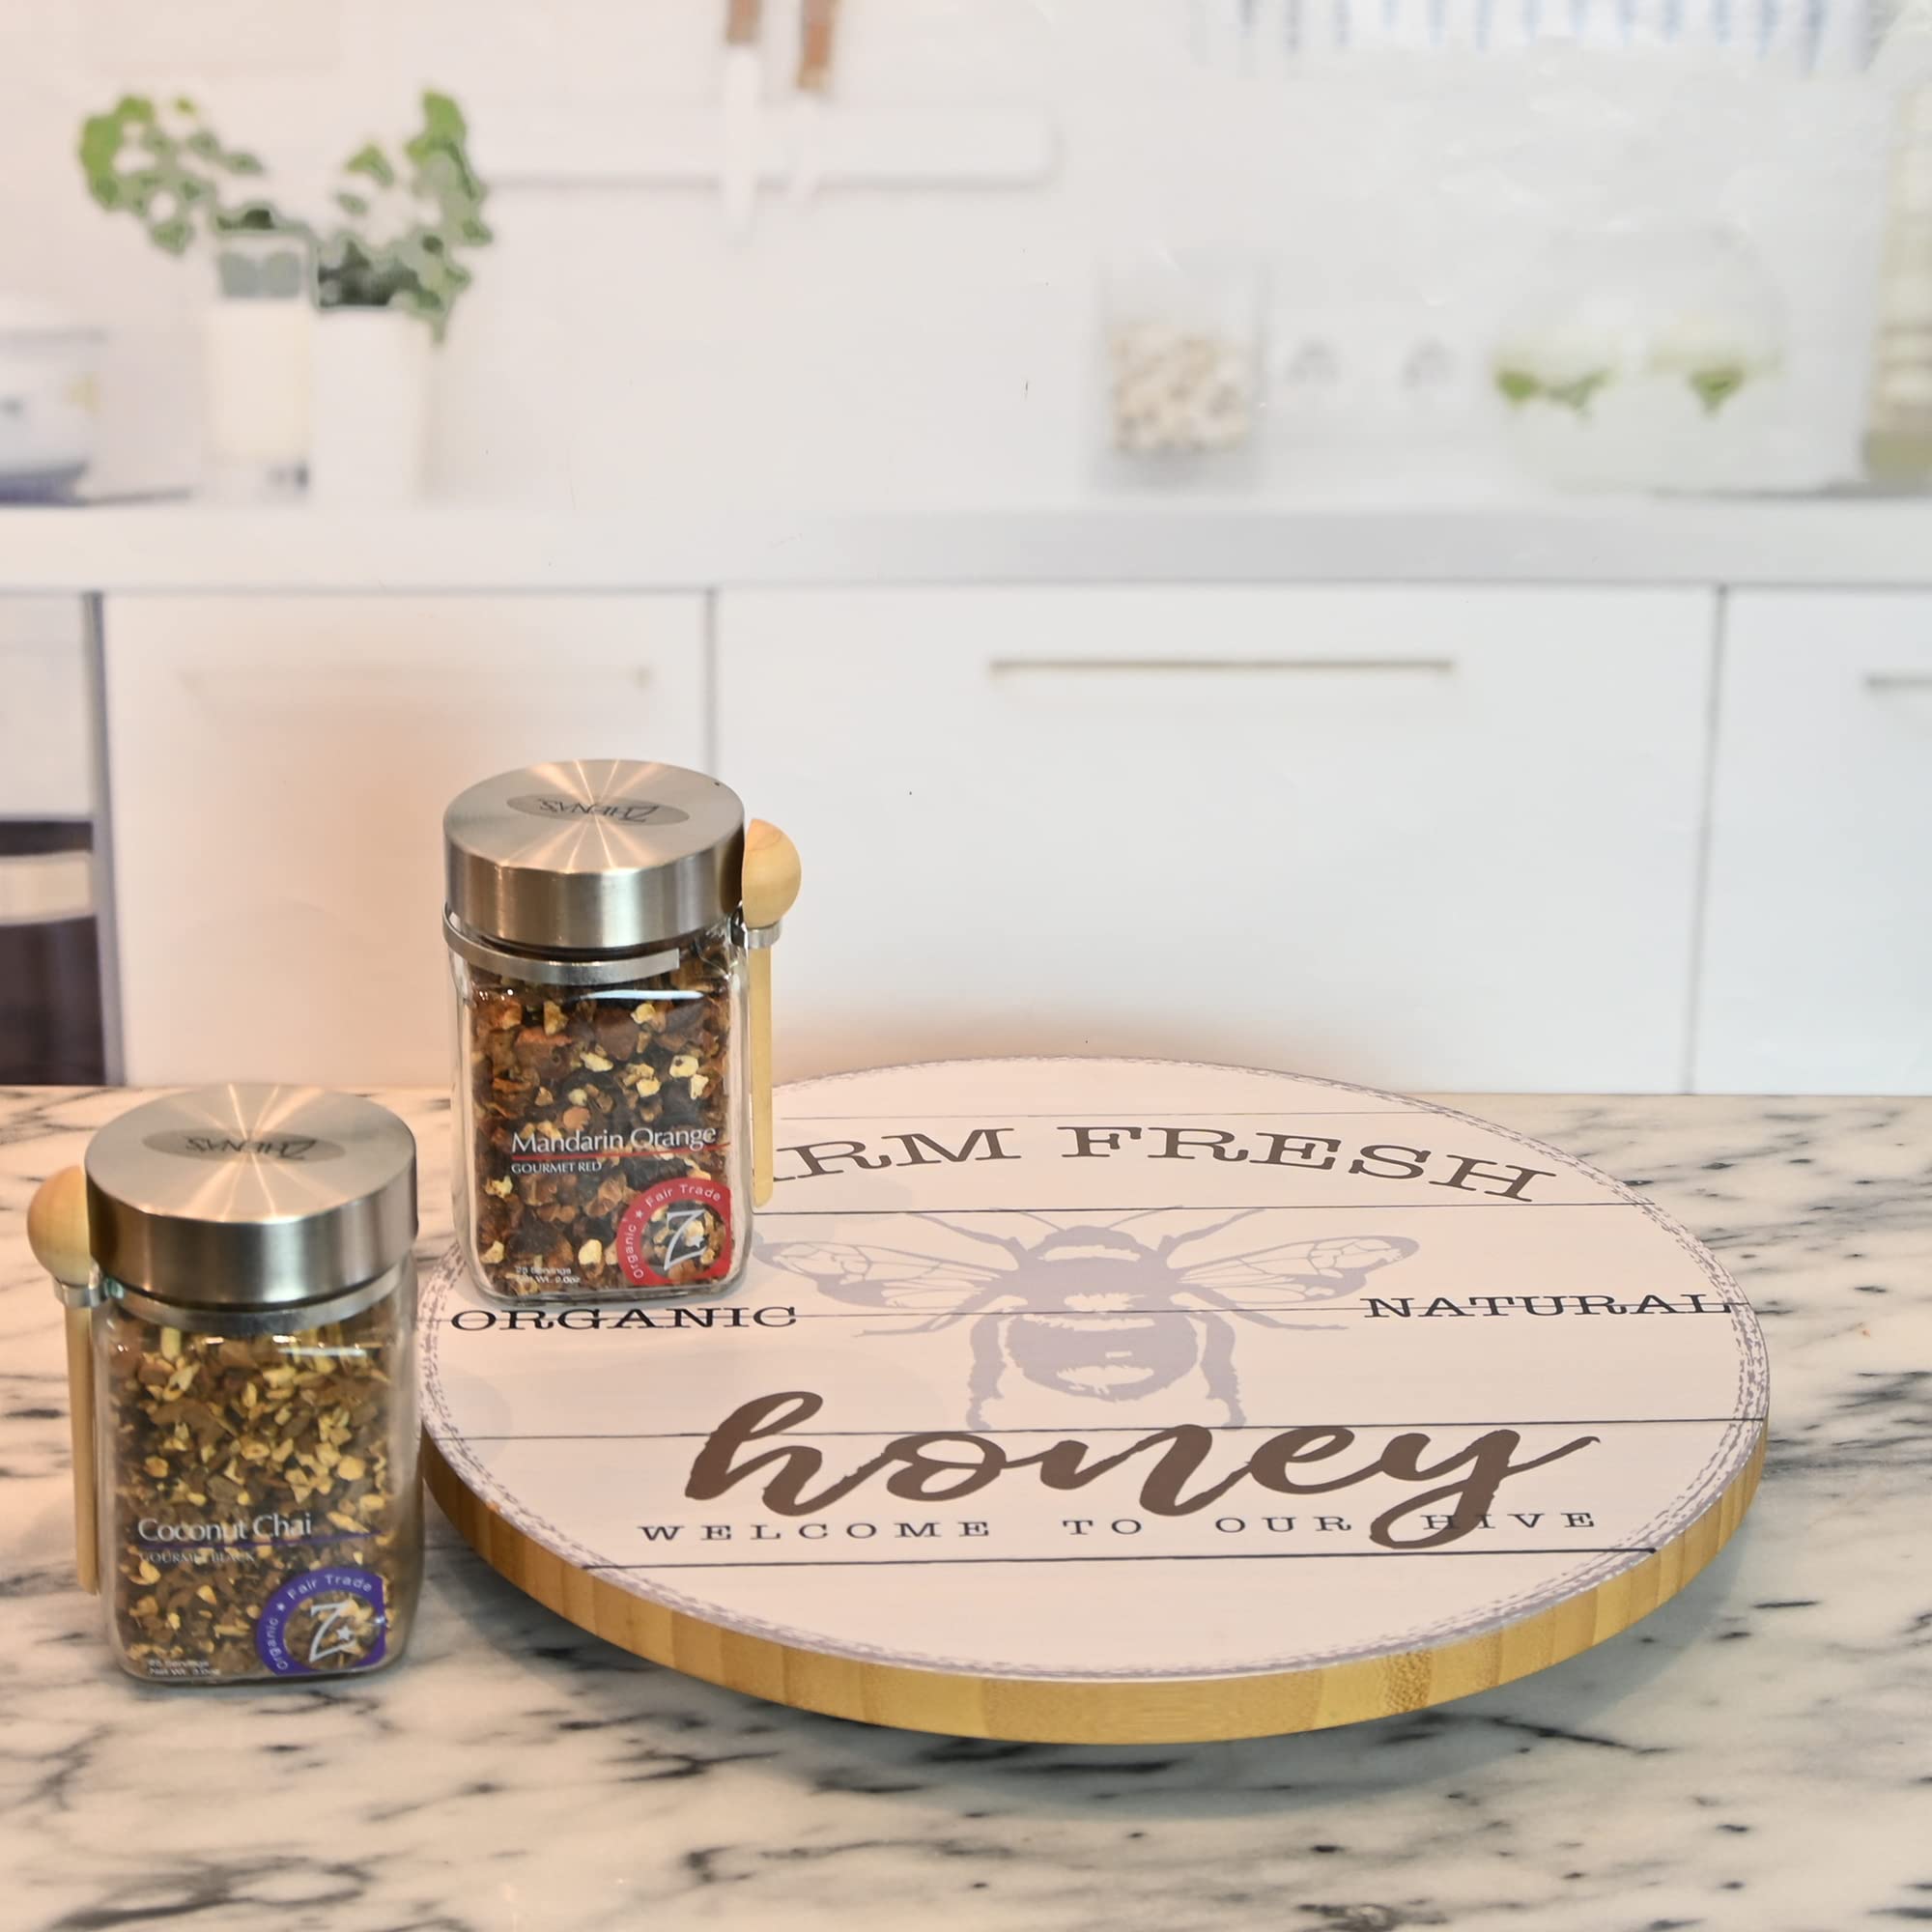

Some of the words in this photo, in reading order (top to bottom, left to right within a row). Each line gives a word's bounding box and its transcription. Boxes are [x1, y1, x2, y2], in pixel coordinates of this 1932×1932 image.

[511, 1128, 624, 1153] Mandarin
[630, 1126, 717, 1152] Orange
[511, 1161, 575, 1175] GOURMET
[578, 1161, 603, 1173] RED
[773, 1127, 1023, 1182] RM
[1057, 1125, 1557, 1203] FRESH
[625, 1224, 645, 1279] Organic
[644, 1187, 674, 1208] Fair
[679, 1183, 722, 1202] Trade
[450, 1305, 798, 1331] ORGANIC
[1359, 1293, 1732, 1319] NATURAL
[684, 1390, 1602, 1549] honey
[137, 1517, 247, 1543] Coconut
[252, 1511, 312, 1538] Chai
[638, 1520, 991, 1542] WELCOME
[1063, 1519, 1143, 1536] TO
[1214, 1517, 1352, 1533] OUR
[1420, 1512, 1596, 1530] HIVE
[266, 1617, 289, 1671] Organic
[287, 1578, 318, 1601] Fair
[325, 1574, 373, 1593] Trade
